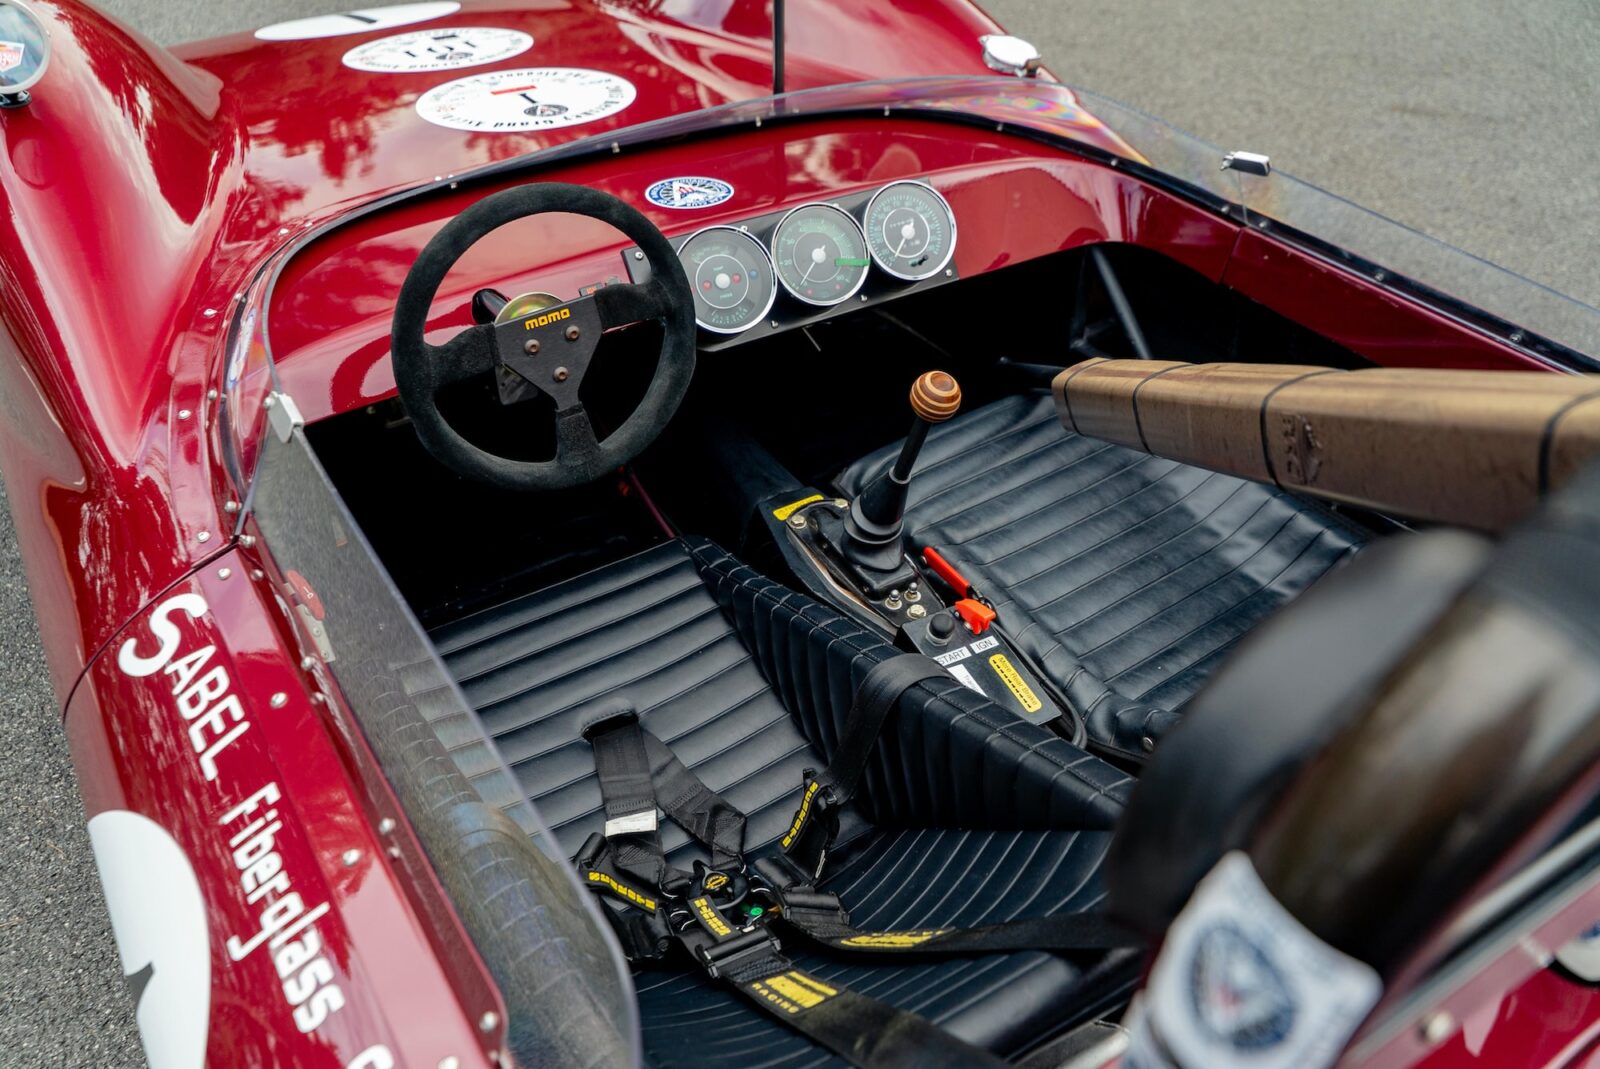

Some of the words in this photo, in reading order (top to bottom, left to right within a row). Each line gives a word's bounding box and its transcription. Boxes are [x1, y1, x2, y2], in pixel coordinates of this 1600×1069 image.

[936, 648, 966, 665] START
[218, 781, 346, 1034] Fiberglass
[750, 982, 800, 1014] RACING
